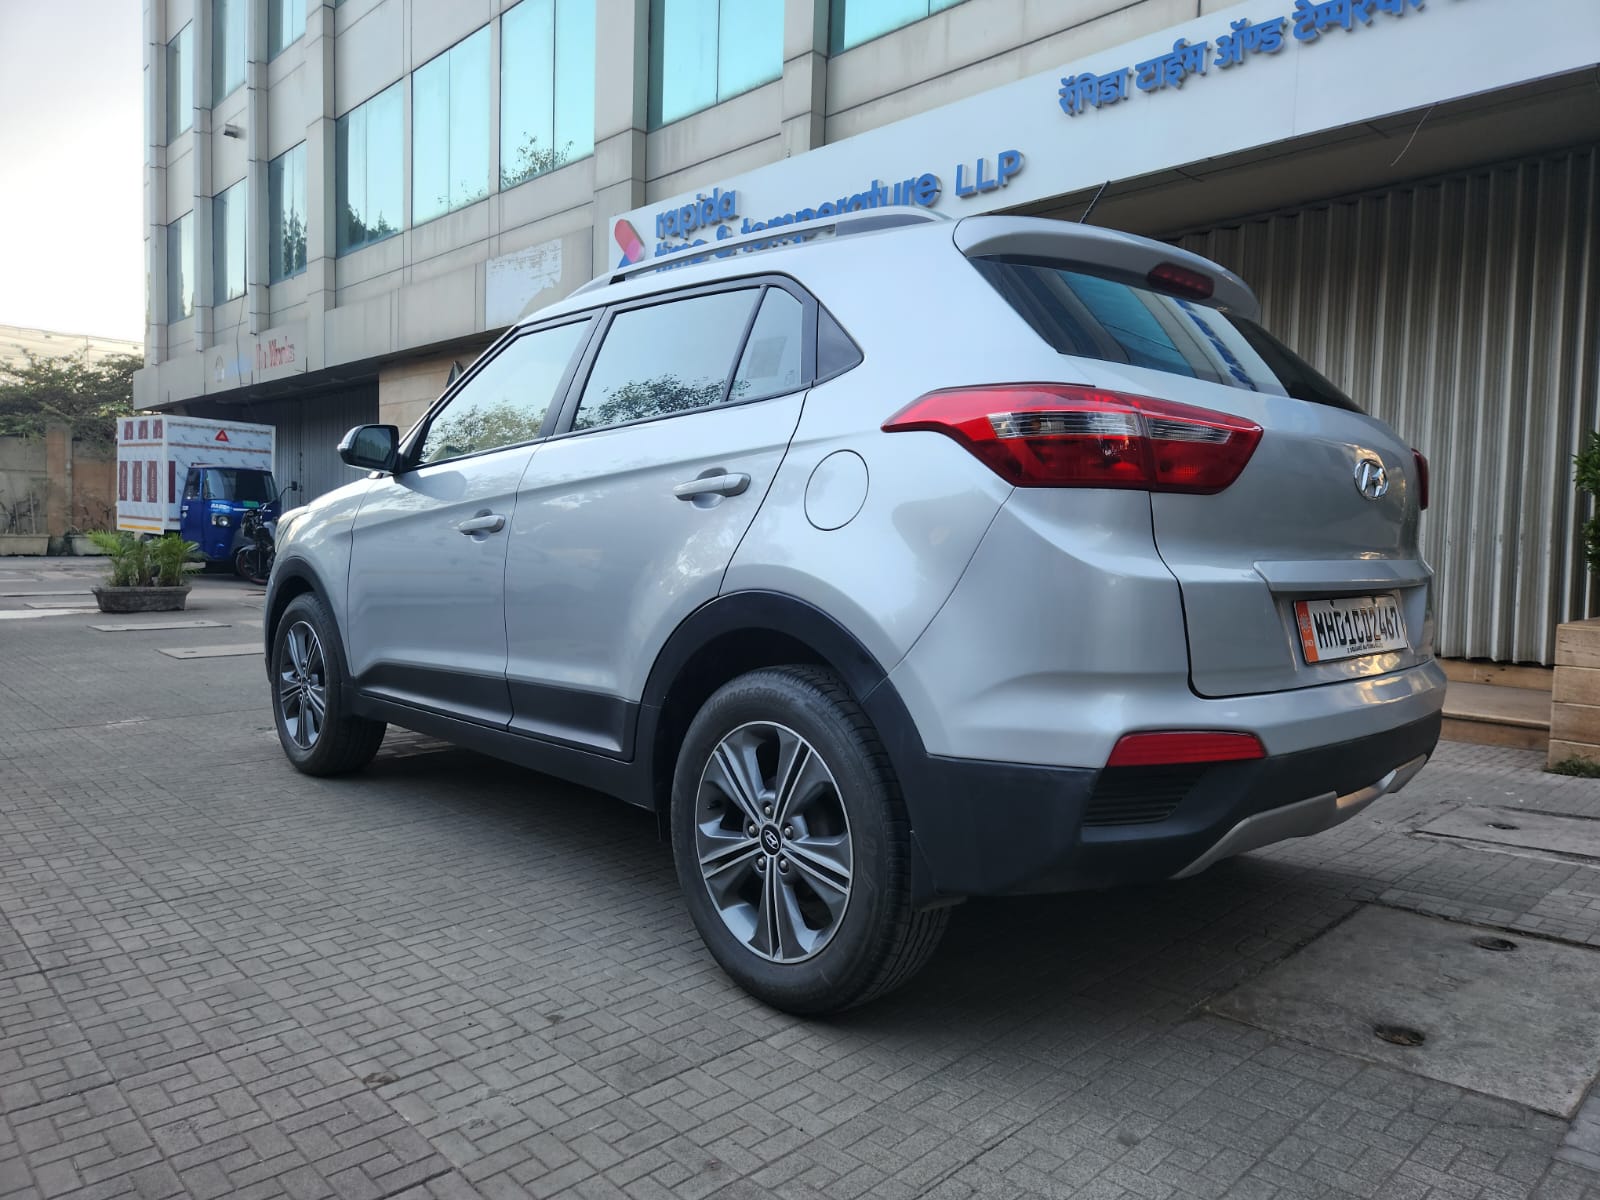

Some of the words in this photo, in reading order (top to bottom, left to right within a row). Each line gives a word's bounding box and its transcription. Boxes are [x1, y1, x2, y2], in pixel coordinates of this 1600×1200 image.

[955, 149, 1025, 198] LLP
[655, 186, 739, 240] rapida
[1312, 606, 1402, 649] MH01CD2467
